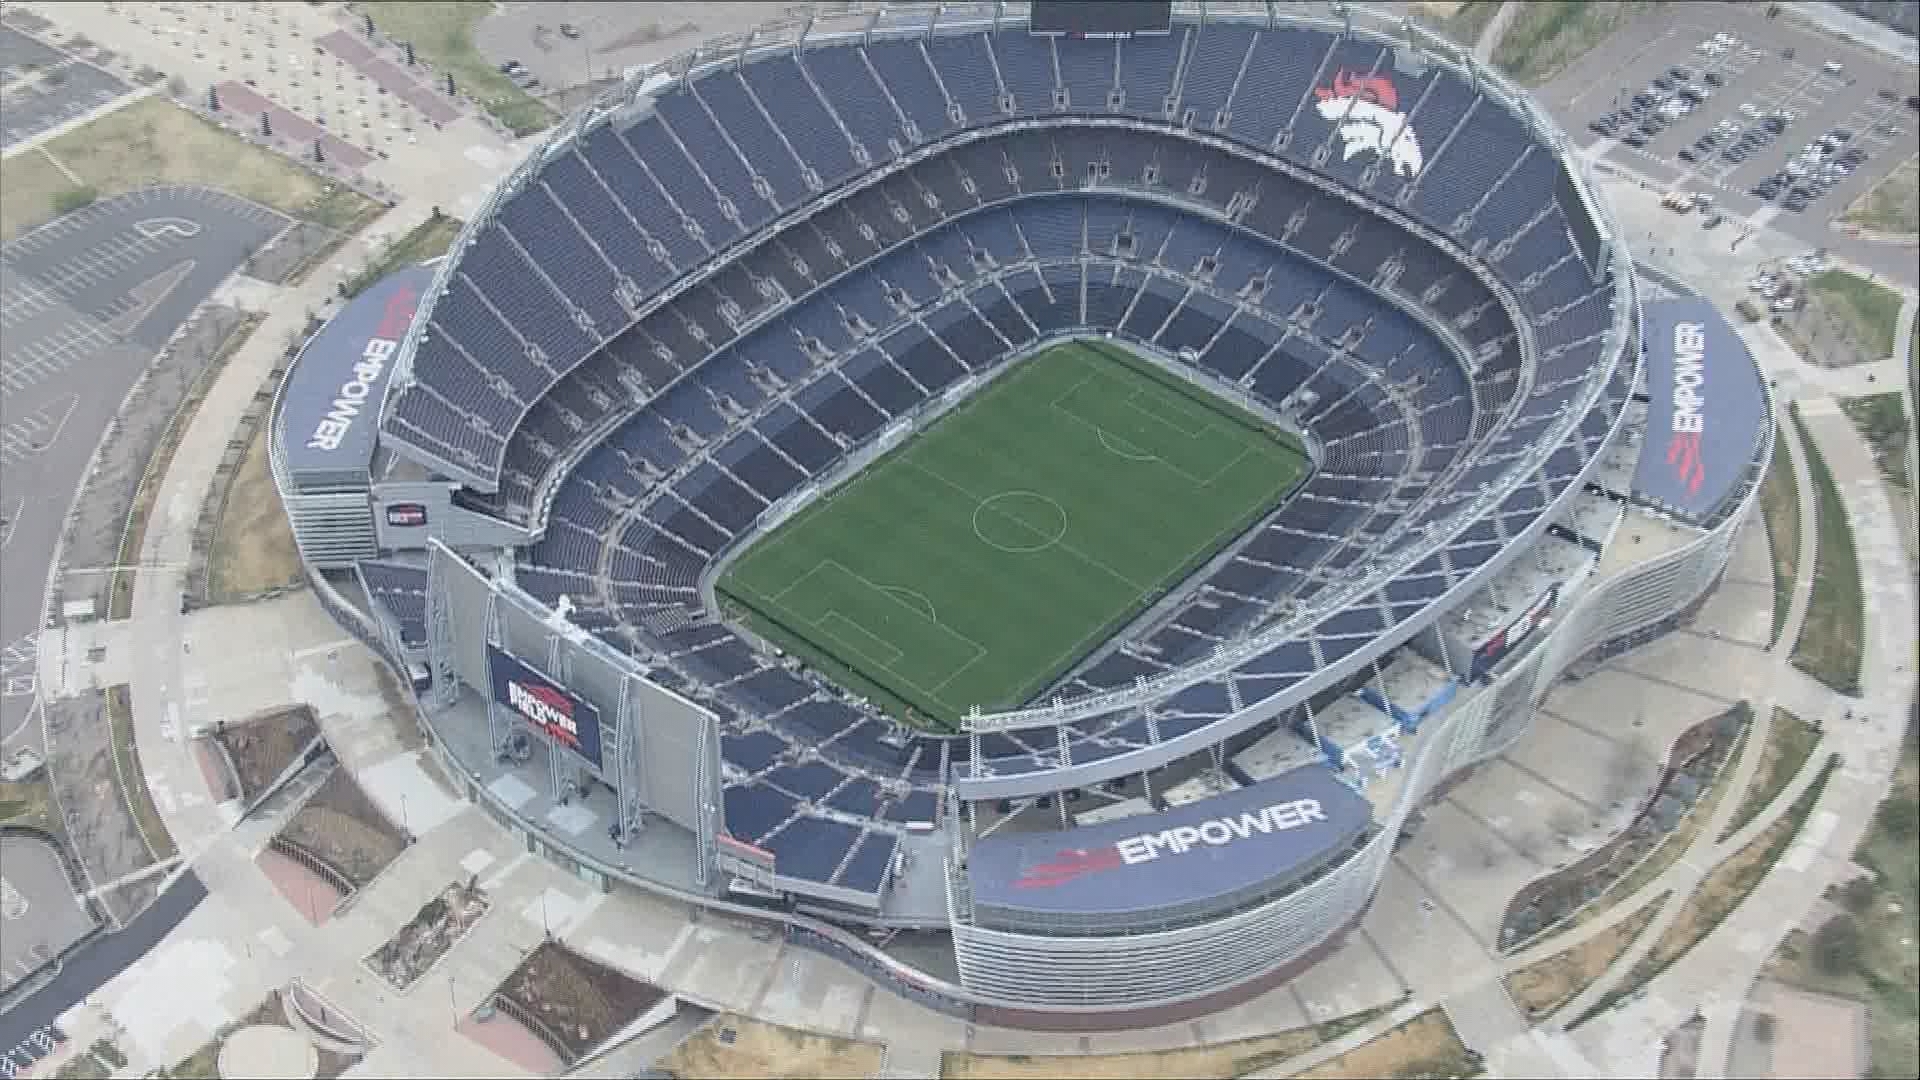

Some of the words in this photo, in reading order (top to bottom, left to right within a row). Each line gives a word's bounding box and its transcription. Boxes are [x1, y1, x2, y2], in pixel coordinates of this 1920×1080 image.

[307, 337, 398, 450] EMPOWER
[1672, 321, 1705, 433] EMPOWER
[1116, 798, 1328, 864] EMPOWER
